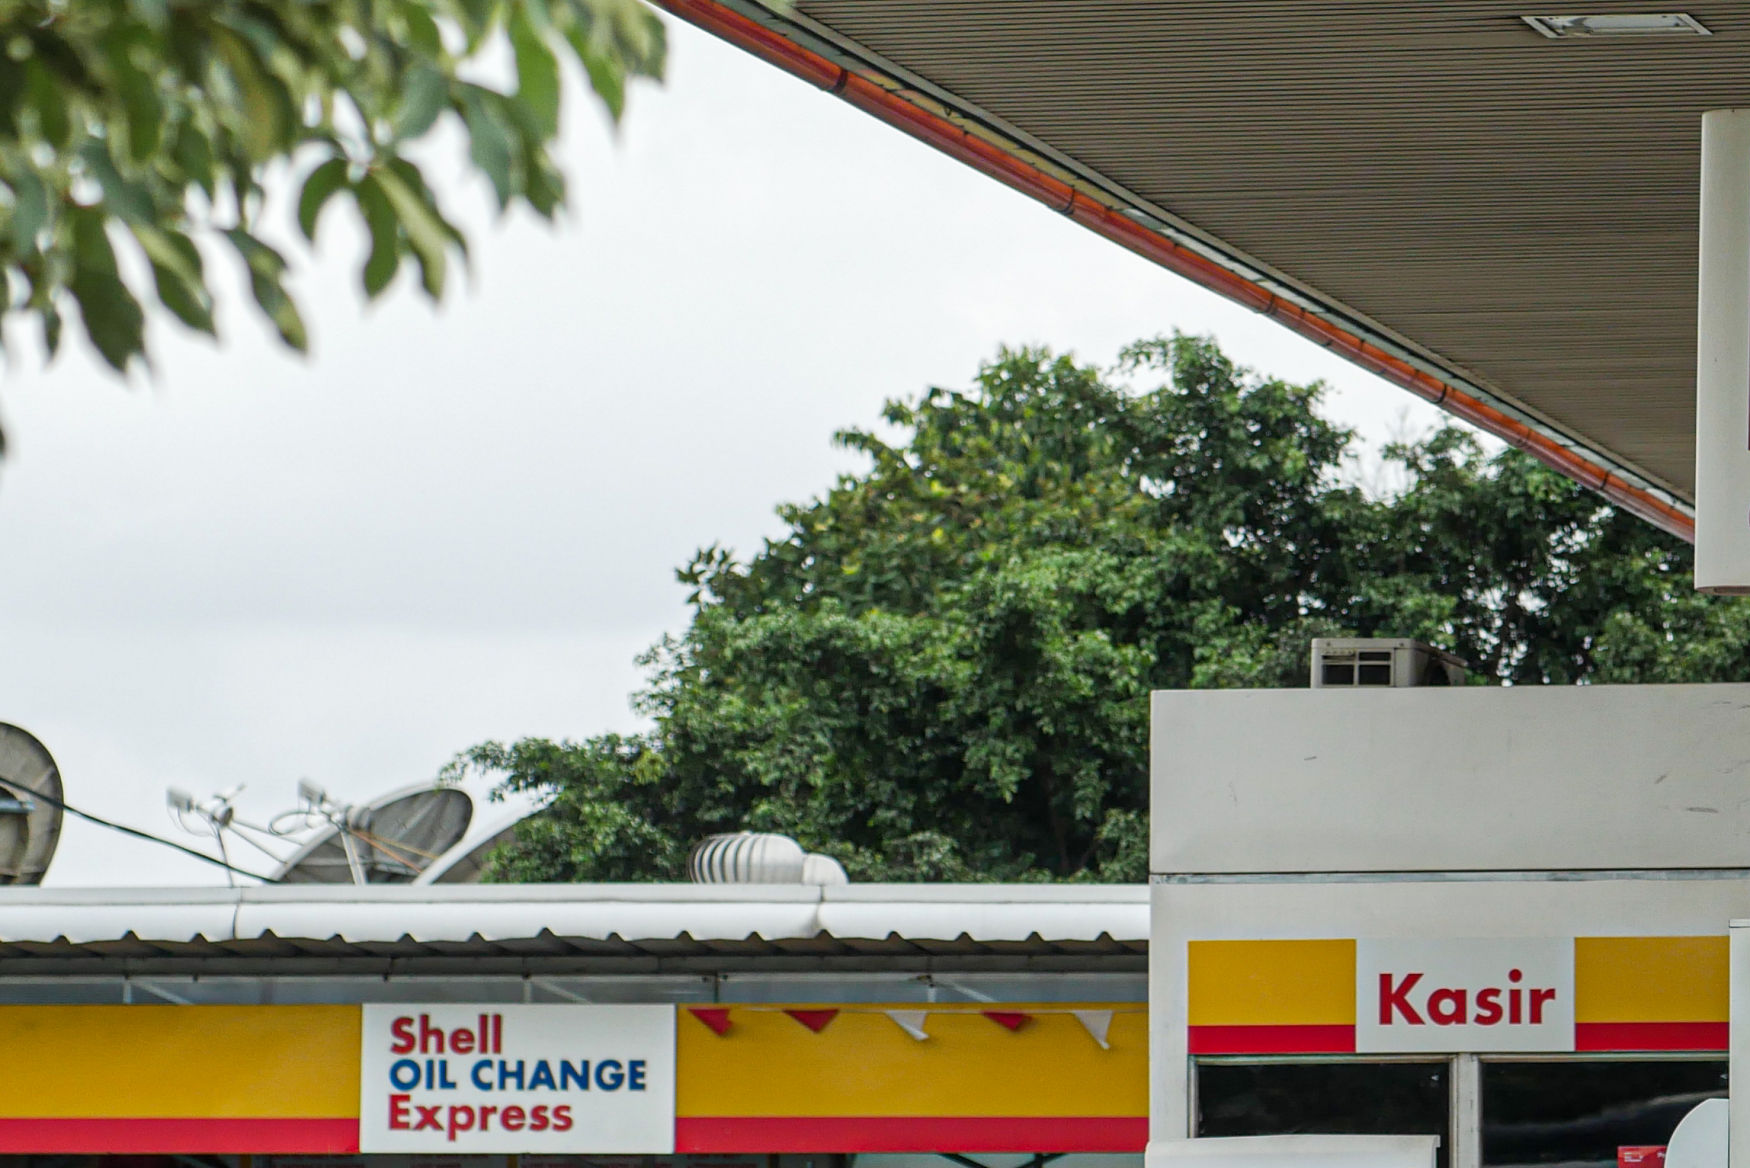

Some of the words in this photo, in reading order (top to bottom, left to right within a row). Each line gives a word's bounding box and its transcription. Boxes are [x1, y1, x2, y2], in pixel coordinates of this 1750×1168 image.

[1379, 968, 1556, 1026] Kasir
[390, 1014, 503, 1054] Shell
[389, 1059, 457, 1091] OIL
[471, 1059, 647, 1091] CHANGE
[388, 1094, 574, 1142] Express
